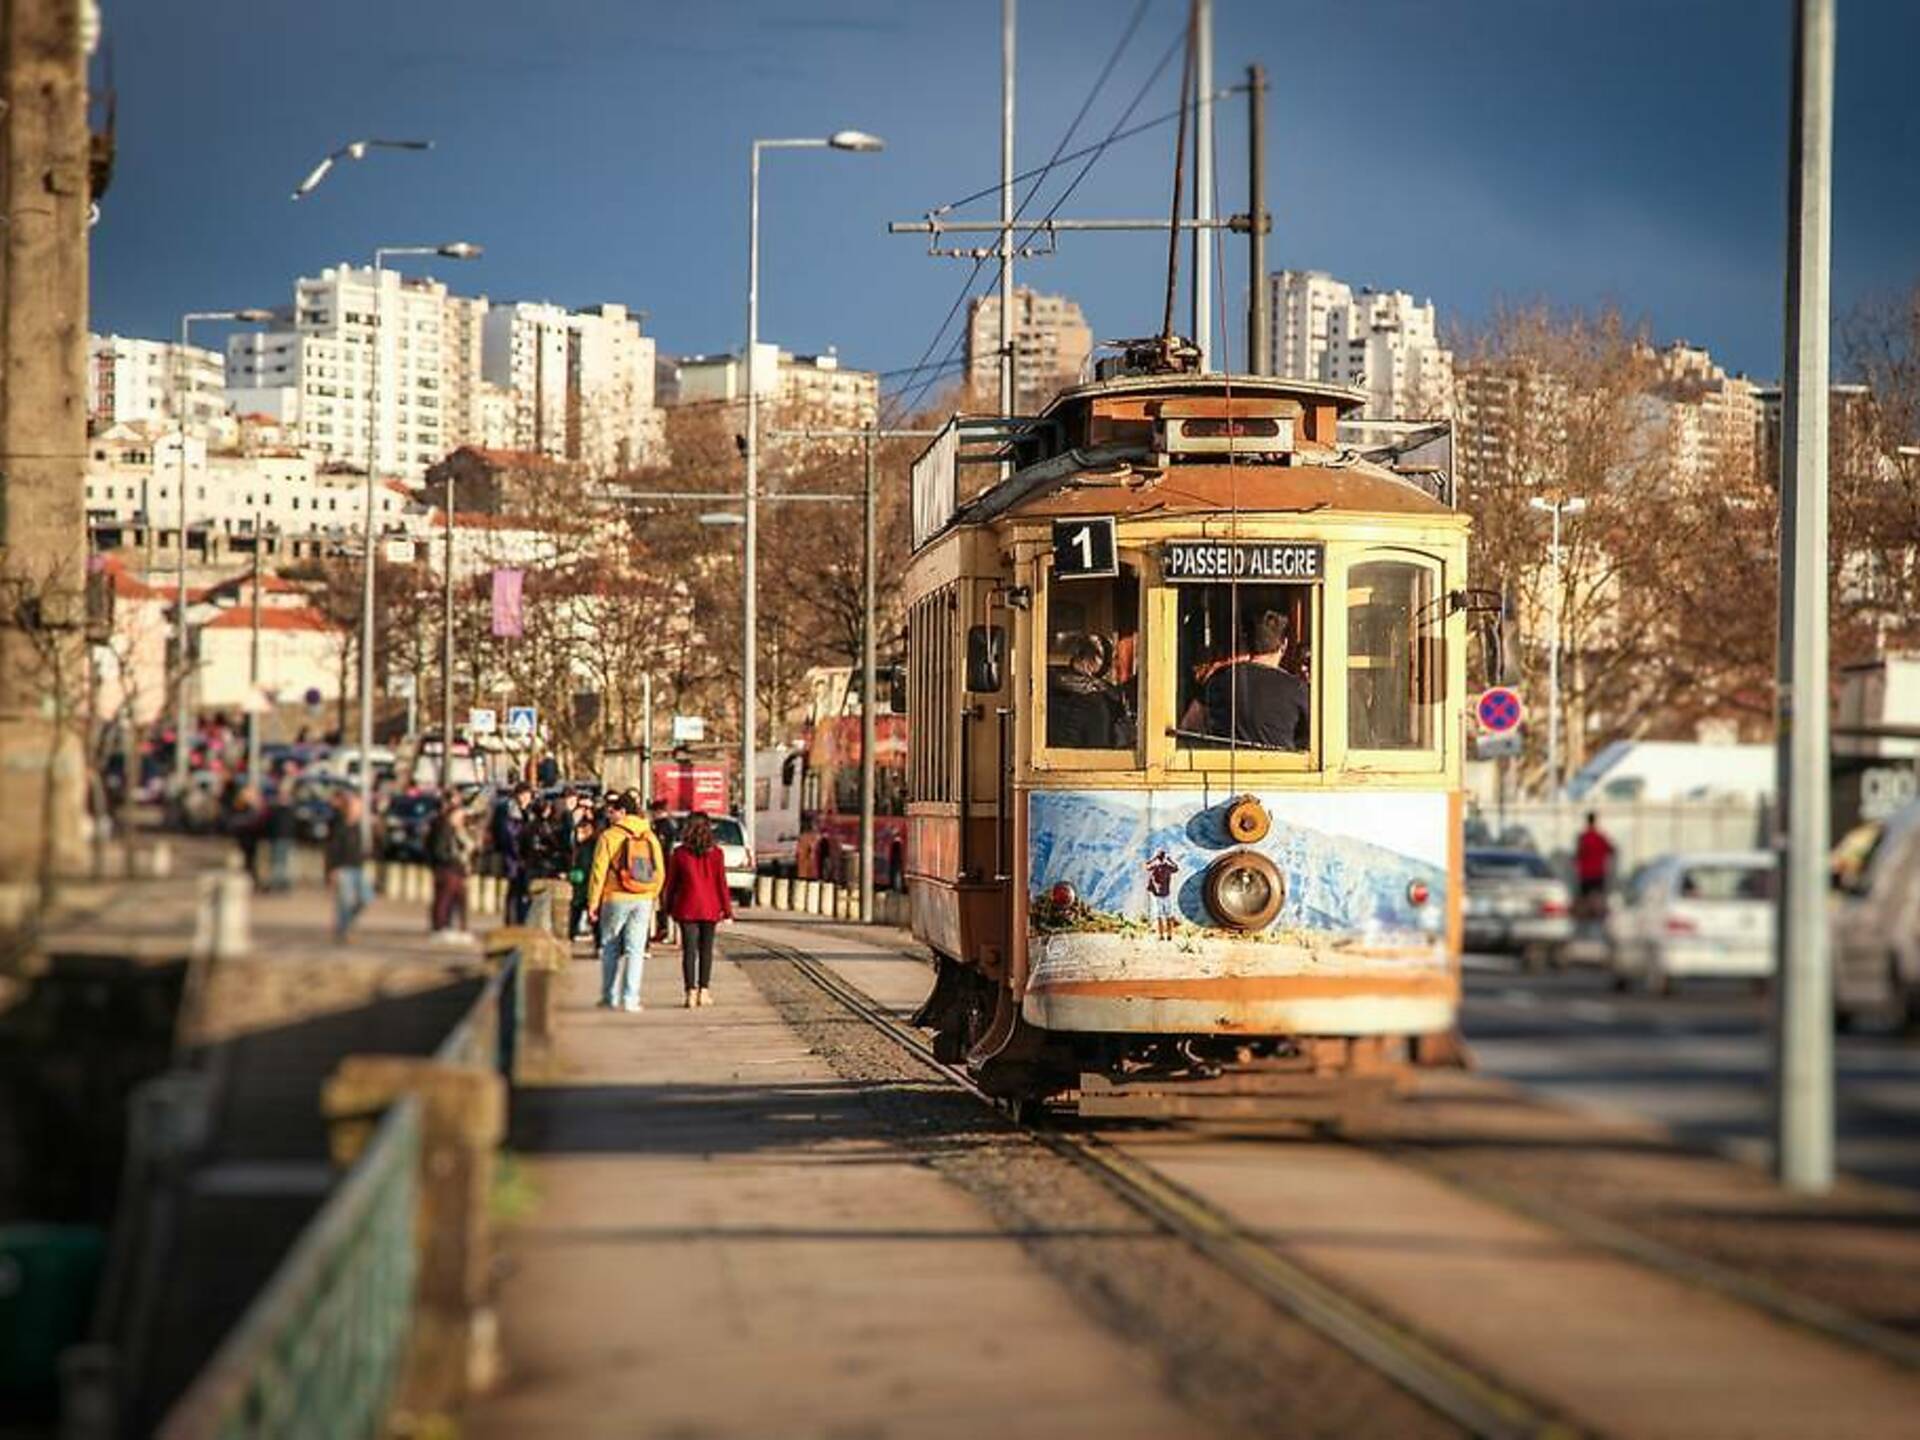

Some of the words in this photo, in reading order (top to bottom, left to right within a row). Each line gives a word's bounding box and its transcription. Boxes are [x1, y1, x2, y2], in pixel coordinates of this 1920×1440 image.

[1071, 525, 1092, 568] 1
[1172, 547, 1245, 575] PASSEIO
[1250, 547, 1316, 575] ALEGRE
